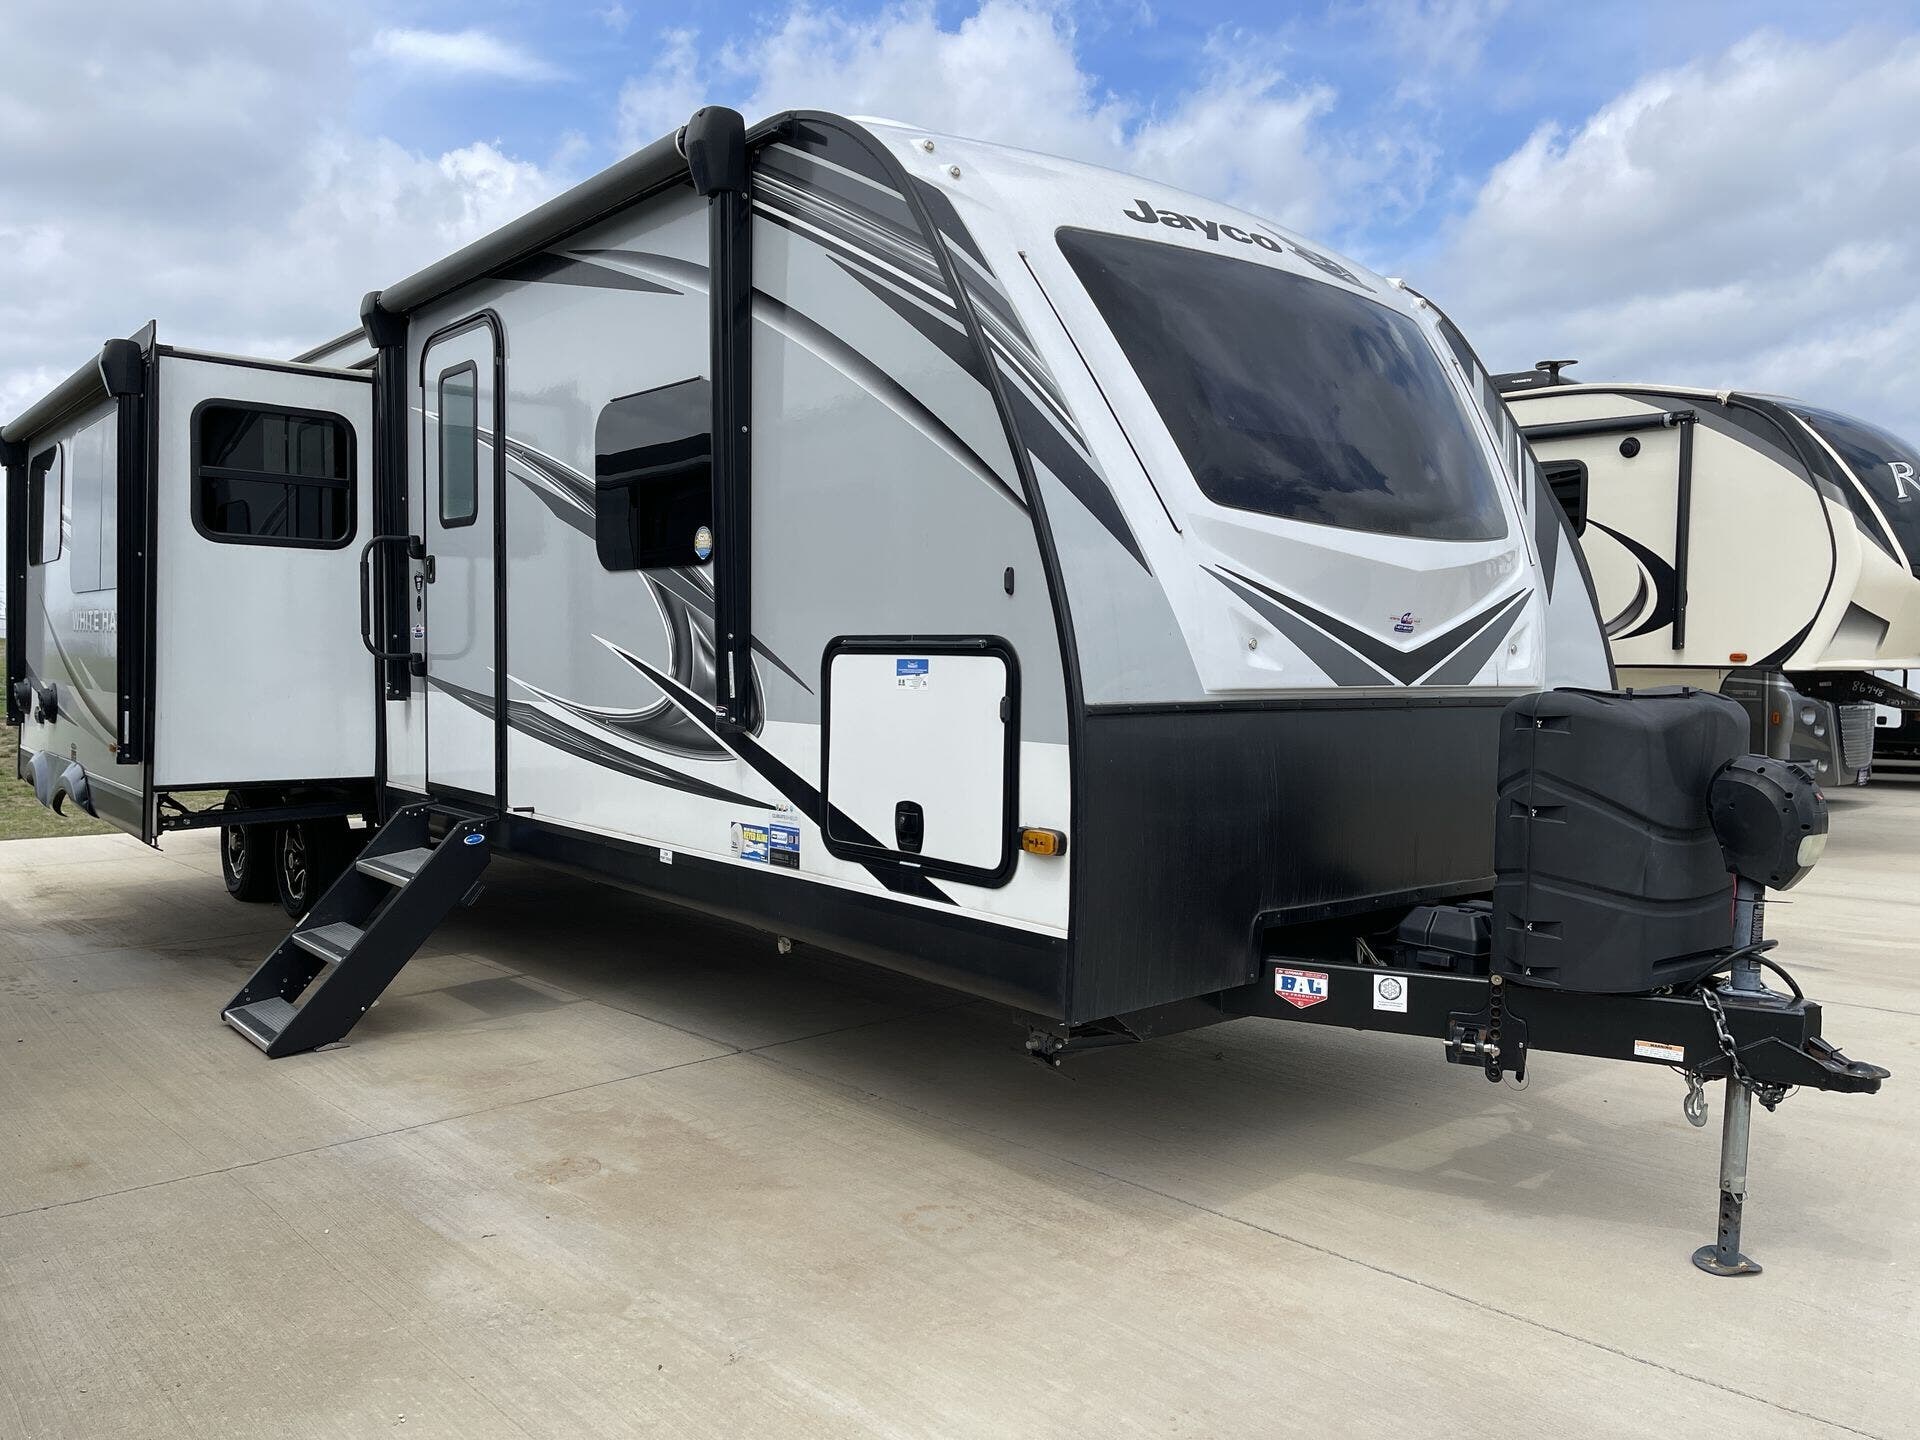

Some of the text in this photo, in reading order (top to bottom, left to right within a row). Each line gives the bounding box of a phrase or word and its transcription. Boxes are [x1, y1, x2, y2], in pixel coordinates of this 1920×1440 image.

[1123, 198, 1283, 253] Jayco
[1887, 461, 1920, 500] R
[72, 609, 117, 631] WHITE HA
[1280, 975, 1323, 995] BAL
